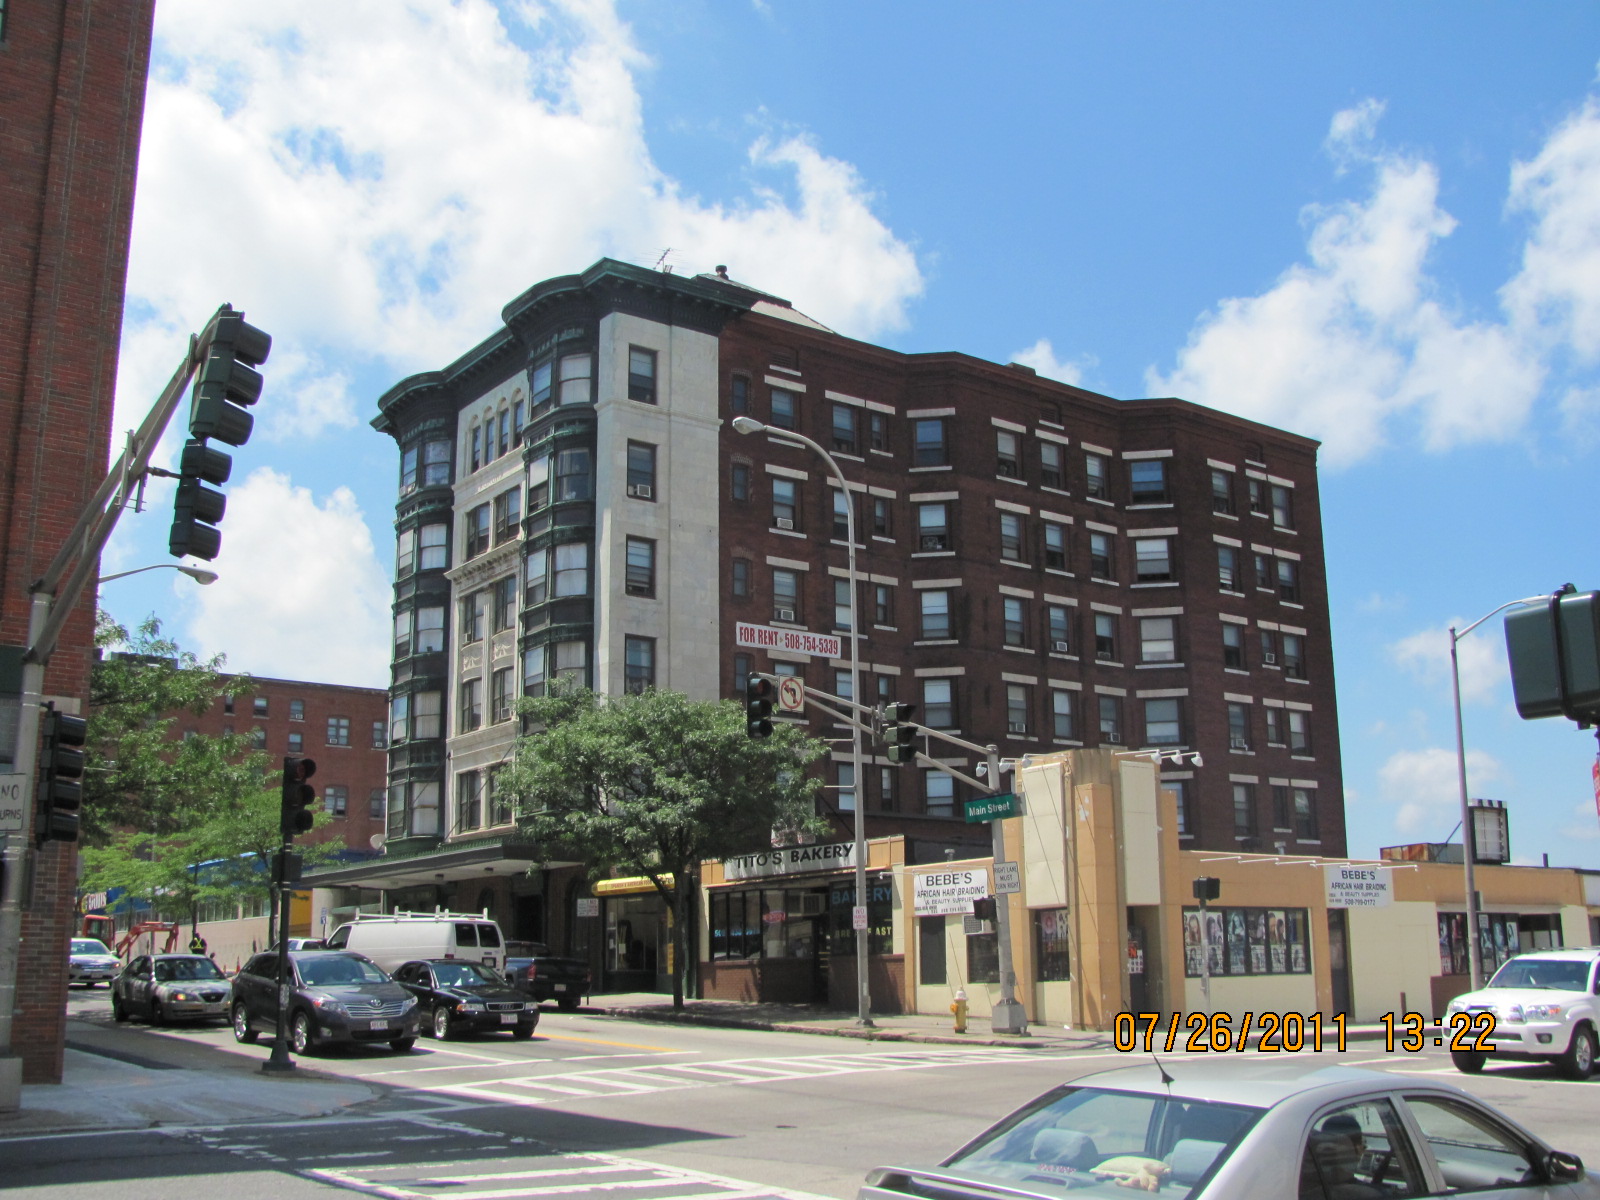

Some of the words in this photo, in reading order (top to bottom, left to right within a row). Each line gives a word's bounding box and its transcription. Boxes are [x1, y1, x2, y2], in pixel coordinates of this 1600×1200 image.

[739, 626, 756, 643] FOR
[757, 629, 779, 647] RENT
[784, 632, 838, 655] 508-754-5339
[1, 784, 20, 800] NO
[0, 808, 22, 820] URNS
[968, 805, 987, 816] Main
[987, 801, 1010, 814] Street
[736, 852, 783, 869] TITO'S
[790, 843, 853, 863] BAKERY
[926, 872, 973, 887] BEBE'S
[1341, 870, 1376, 880] BEBE'S
[917, 888, 941, 898] AFRICAN
[942, 888, 956, 896] HAIR
[957, 886, 985, 896] BRAIDING
[1331, 882, 1352, 890] AFRICAN
[1365, 883, 1387, 891] BRAIDING
